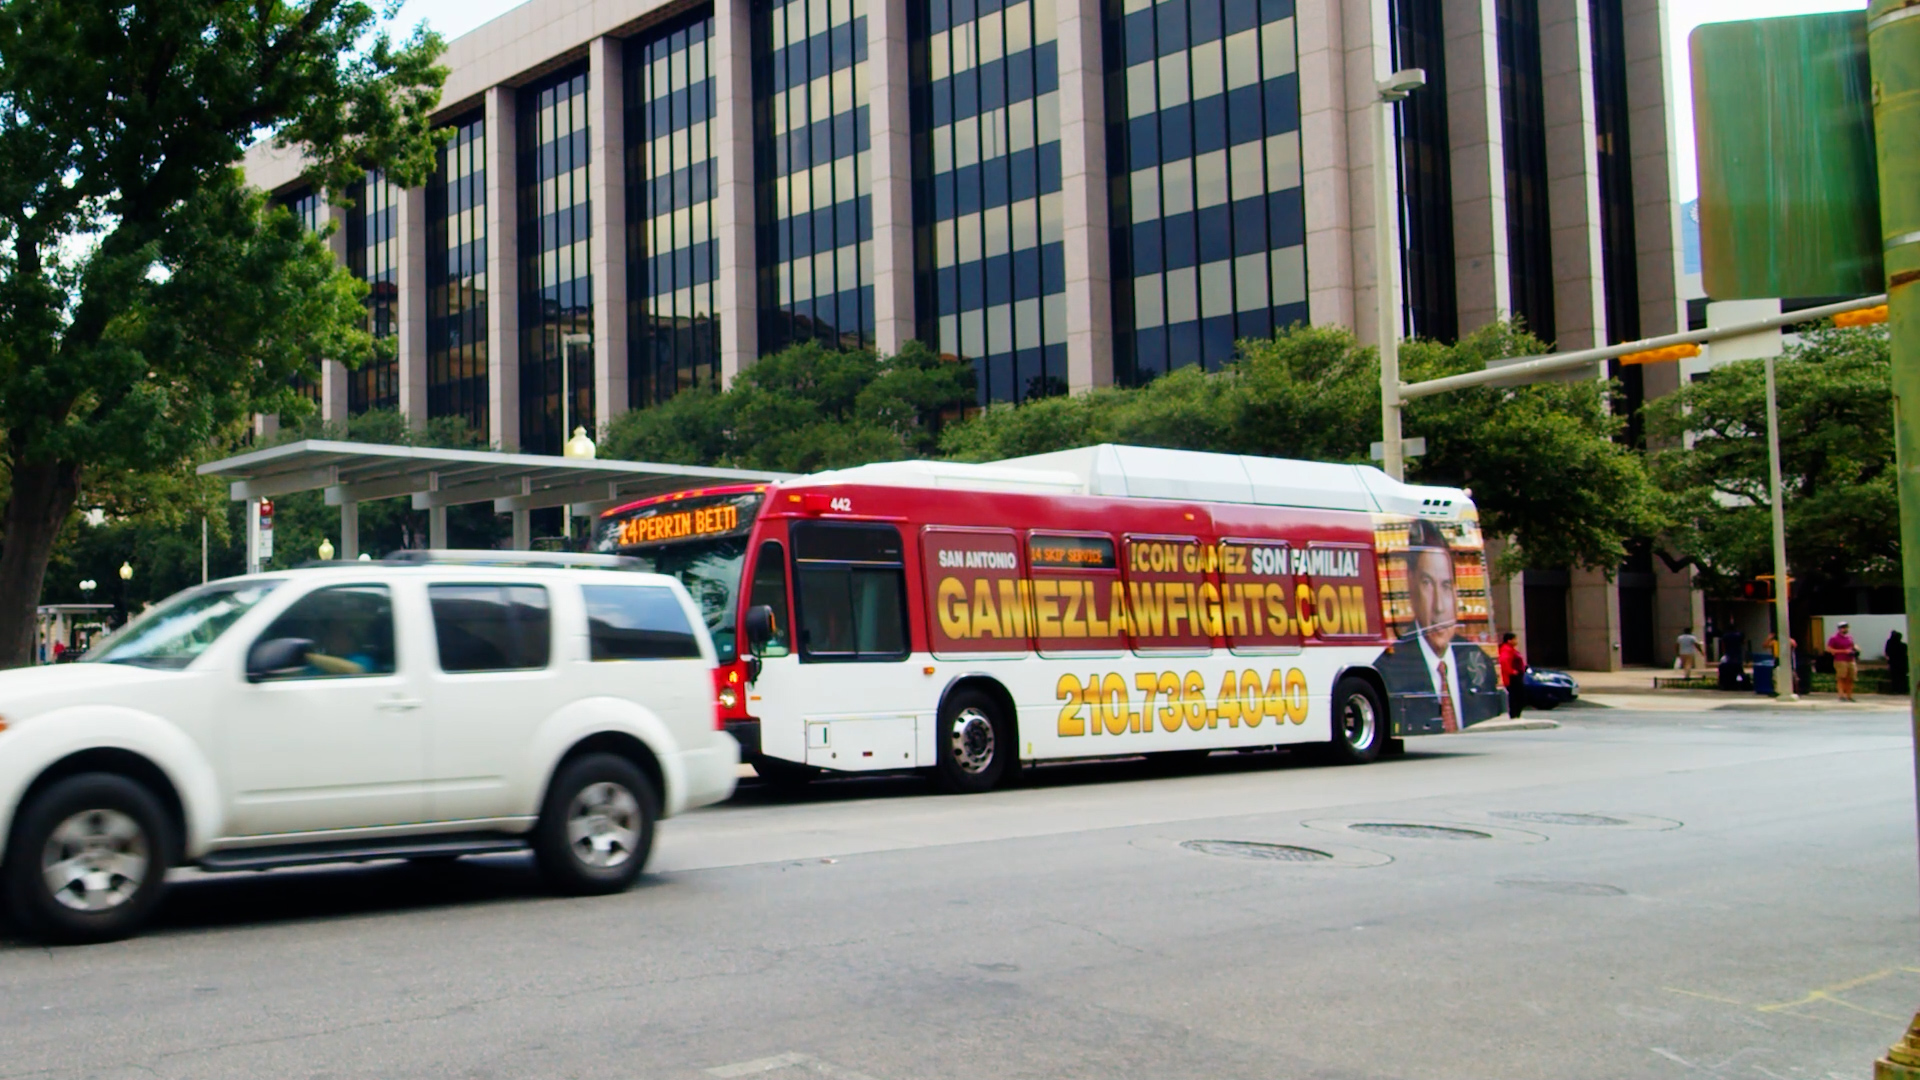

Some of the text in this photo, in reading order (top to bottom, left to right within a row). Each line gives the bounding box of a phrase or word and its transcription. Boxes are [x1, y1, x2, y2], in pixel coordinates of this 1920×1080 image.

[830, 497, 851, 512] 442
[639, 512, 691, 541] PERRIN
[939, 550, 1017, 570] SAN ANTONIO
[1183, 545, 1248, 575] GAMEZ
[1251, 548, 1288, 576] SON
[1290, 548, 1360, 578] FAMILIA!
[936, 576, 1369, 640] GAMEZLAWFIGHTS.COM
[1056, 667, 1309, 738] 210.736.4040
